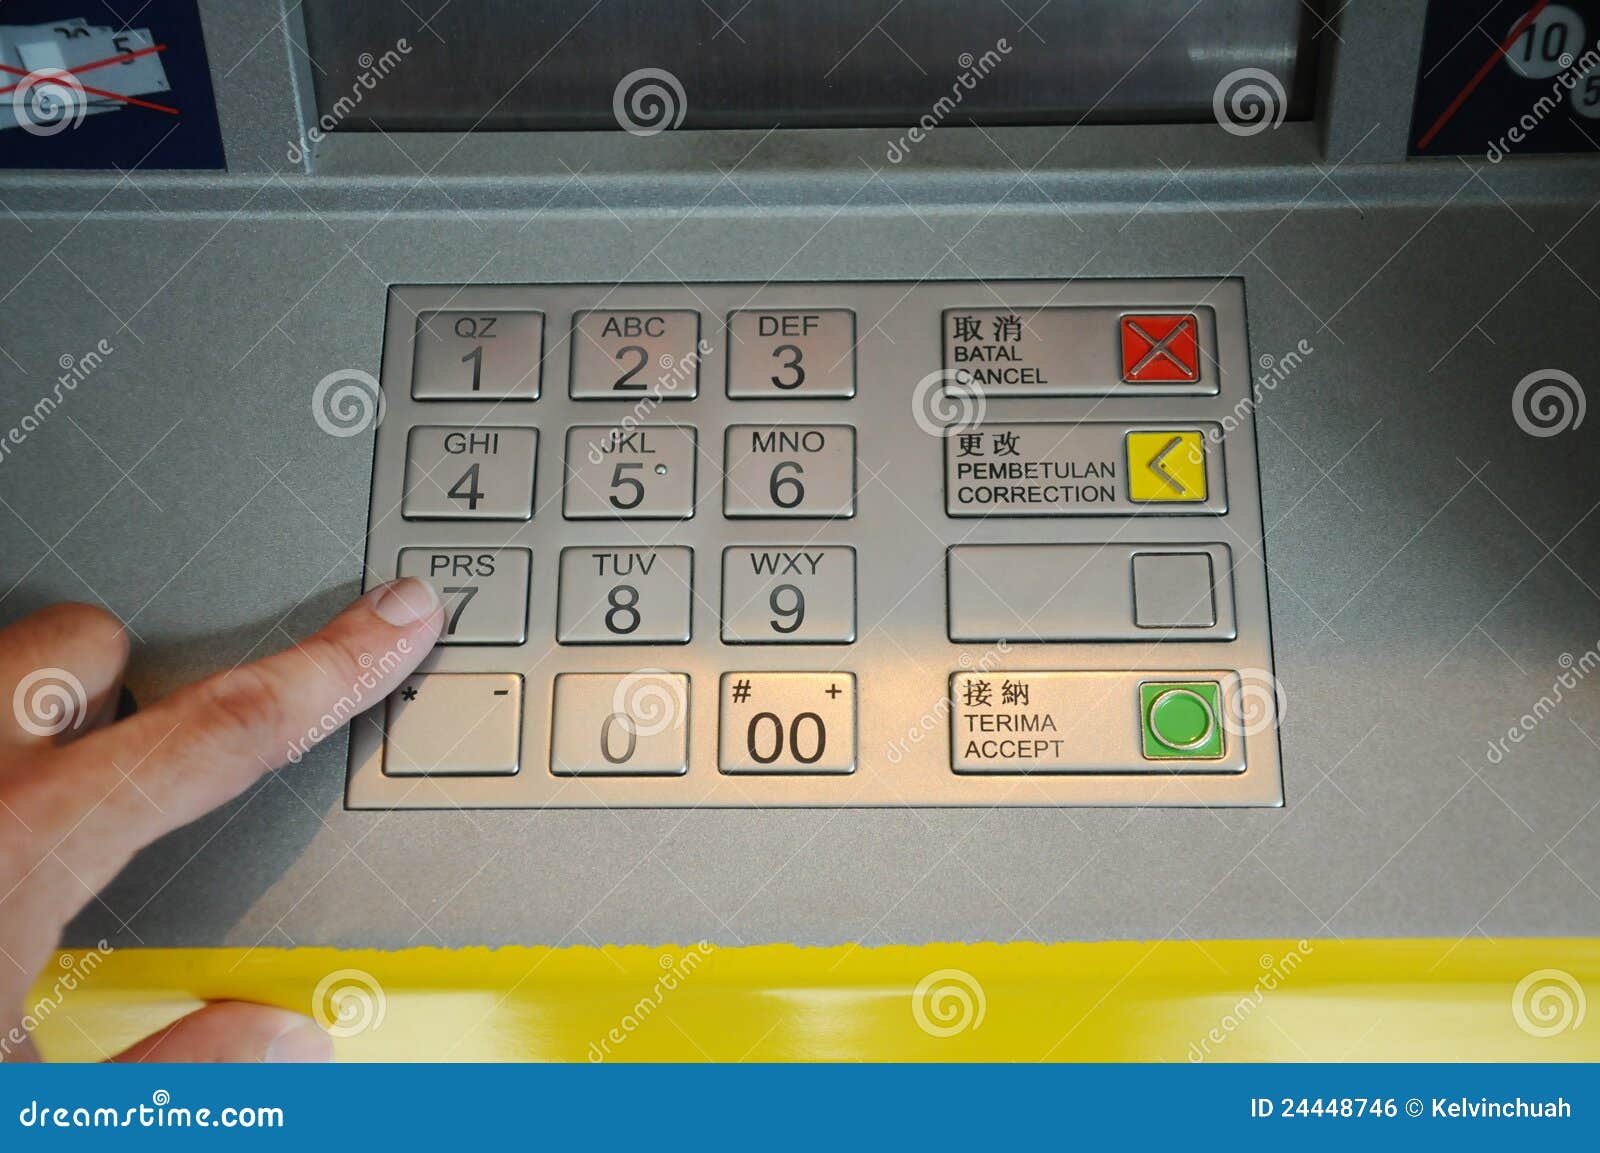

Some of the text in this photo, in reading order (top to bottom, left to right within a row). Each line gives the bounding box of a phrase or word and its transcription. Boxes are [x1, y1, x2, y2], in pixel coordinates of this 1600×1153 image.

[113, 37, 136, 64] 5
[1523, 22, 1568, 62] 10
[455, 314, 497, 338] QZ
[602, 317, 664, 337] ABC
[760, 316, 819, 336] DEF
[953, 315, 1021, 342] 取消
[955, 346, 1022, 362] BATAL
[462, 346, 482, 391] 1
[613, 346, 648, 390] 2
[772, 345, 805, 389] 3
[956, 368, 1048, 385] CANCEL
[445, 433, 498, 454] GHI
[602, 432, 655, 453] JKL
[753, 431, 824, 452] MNO
[957, 431, 1020, 457] 更改
[958, 462, 1115, 479] PEMBETULAN
[448, 464, 484, 510] 4
[609, 463, 644, 509] 5
[770, 462, 804, 508] 6
[958, 486, 1115, 503] CORRECTION
[431, 555, 494, 576] PRS
[592, 554, 656, 576] TUV
[751, 553, 824, 574] WXY
[443, 587, 478, 634] 7
[605, 585, 640, 634] 8
[770, 584, 804, 633] 9
[733, 680, 751, 703] #
[963, 680, 1028, 707] 接納
[964, 715, 1056, 732] TERIMA
[601, 714, 636, 764] 0
[747, 712, 826, 764] 00
[965, 740, 1064, 758] ACCEPT
